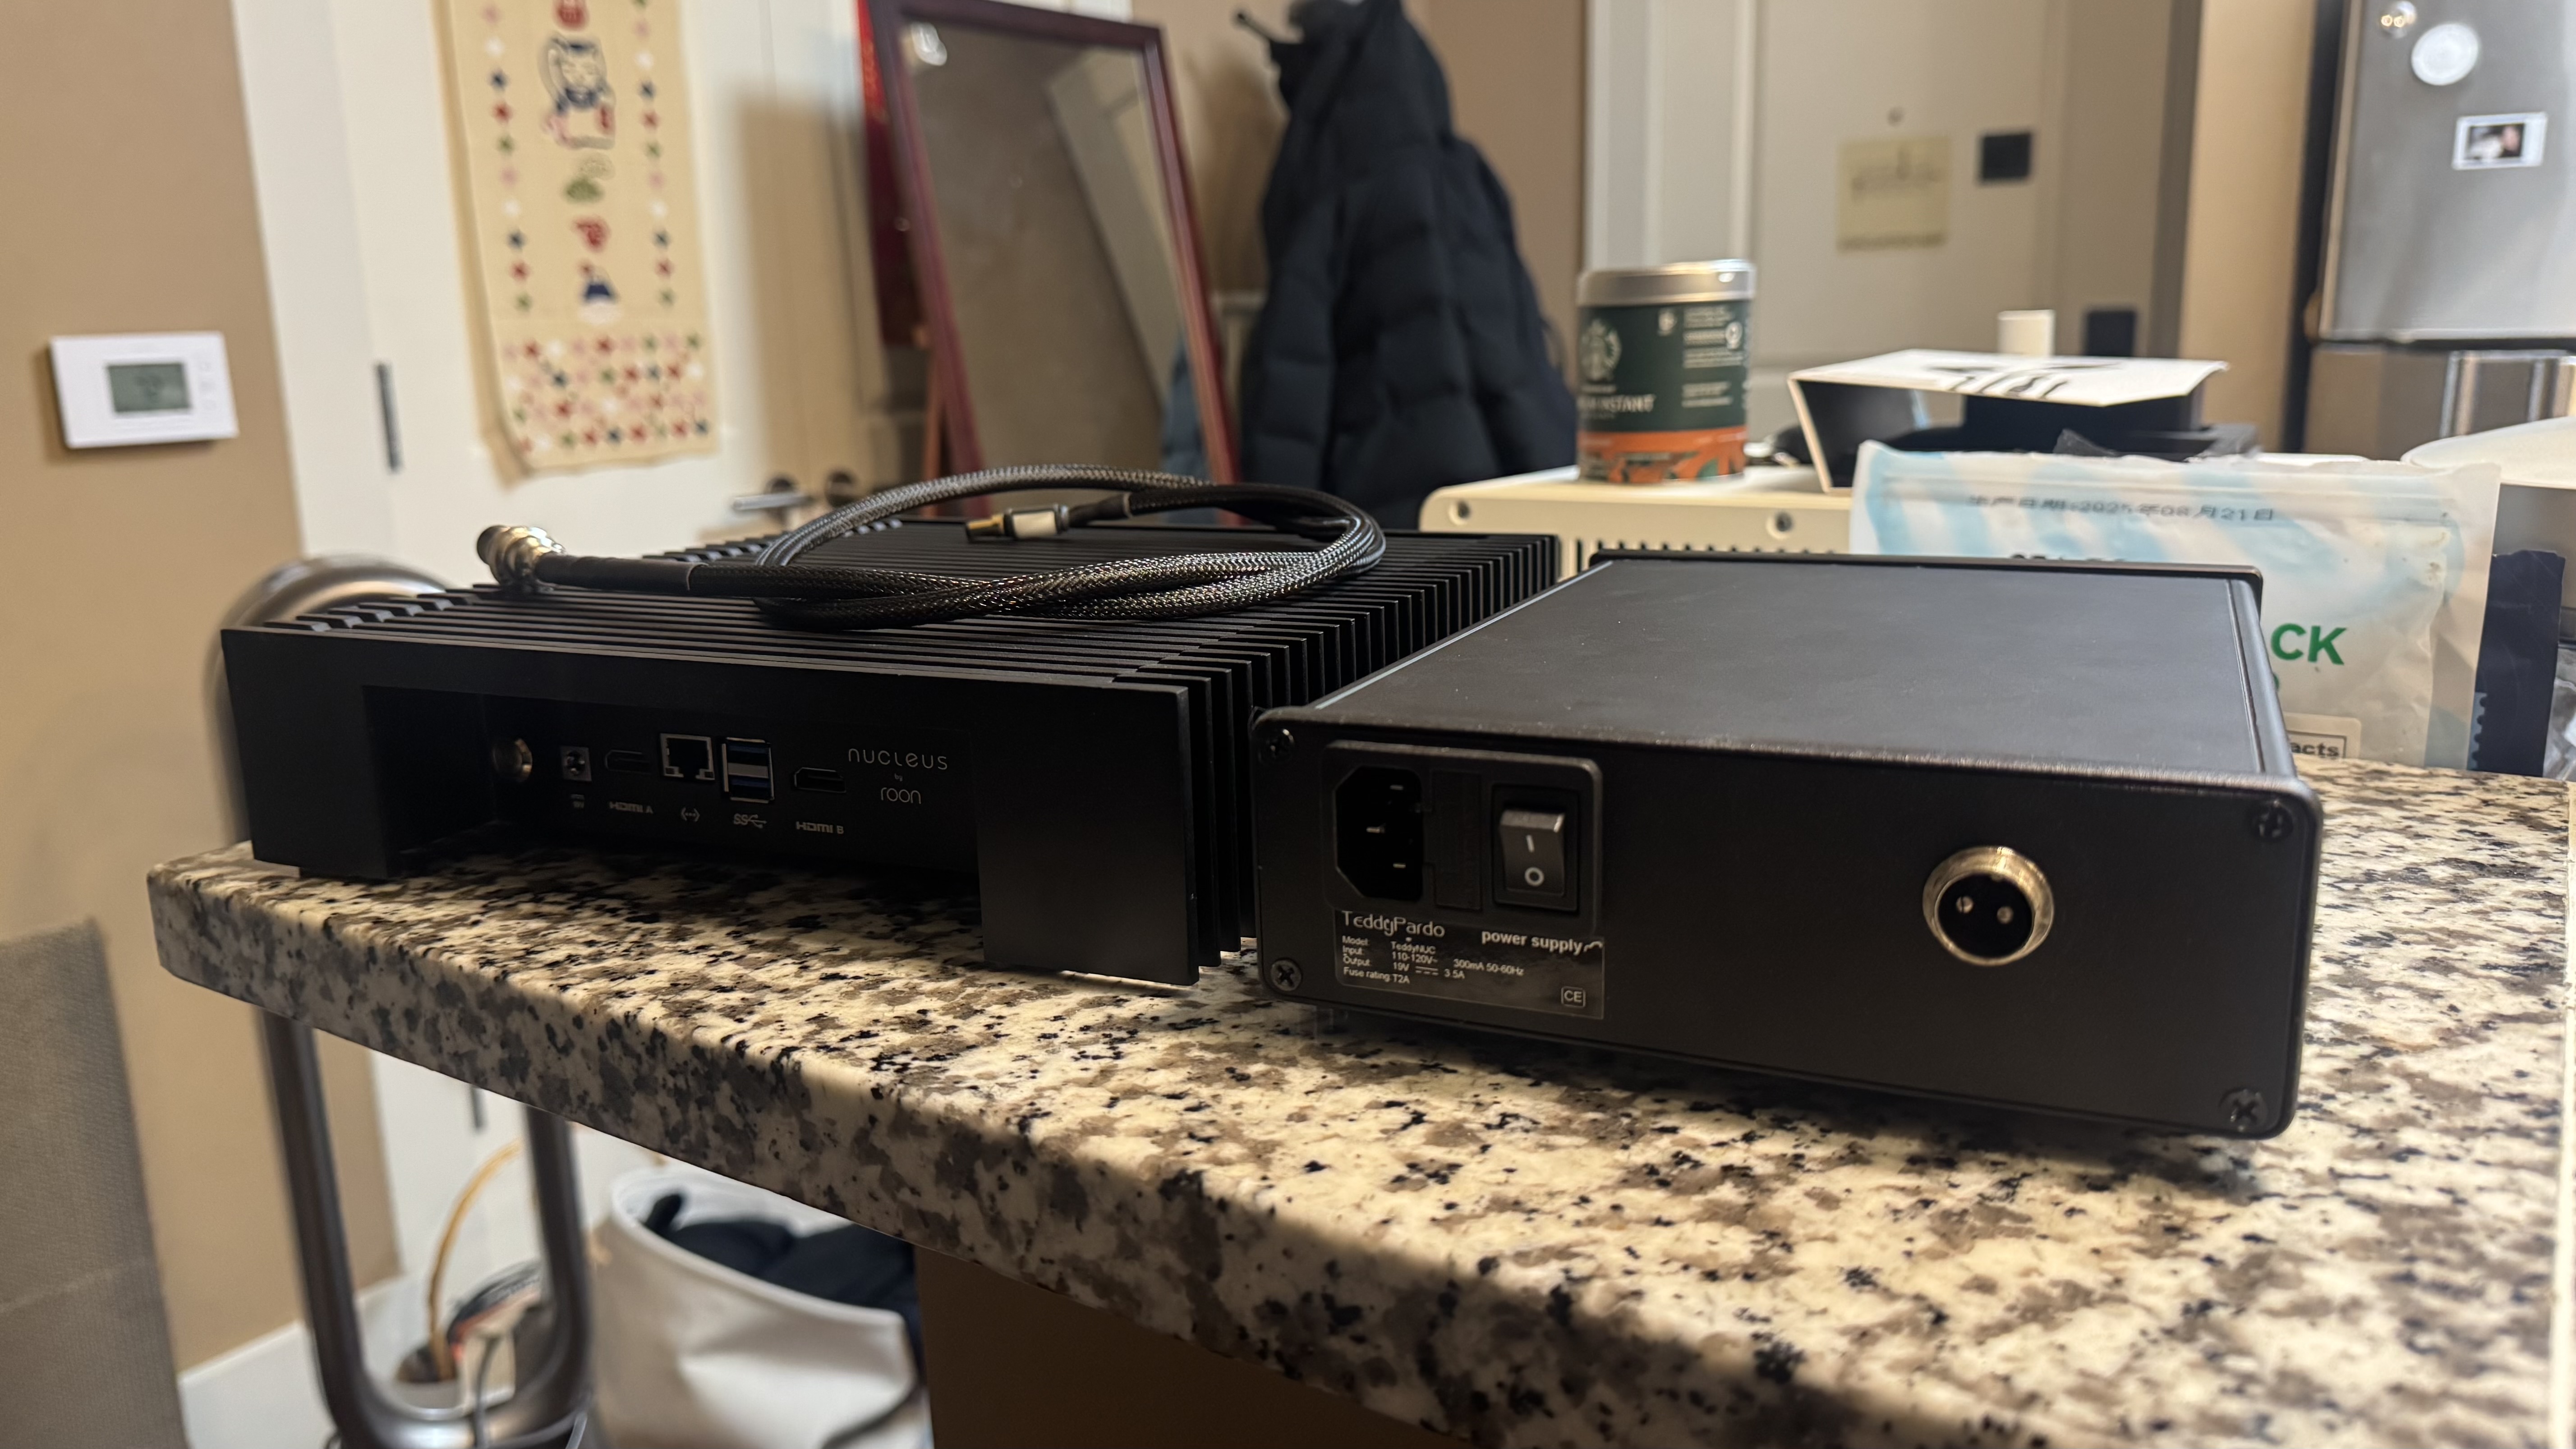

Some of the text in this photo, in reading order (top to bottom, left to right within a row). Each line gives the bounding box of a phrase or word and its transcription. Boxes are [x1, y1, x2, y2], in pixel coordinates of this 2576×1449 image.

[848, 748, 948, 770] nucleus
[894, 773, 903, 782] by
[880, 787, 922, 805] roon
[609, 801, 653, 814] HDMI A
[796, 821, 844, 835] HDMI B
[1342, 910, 1445, 938] TeddyPardo
[1390, 941, 1436, 955] TeddyNUC
[1481, 930, 1583, 956] power supply
[1343, 966, 1411, 984] Fuse rating T2A
[1453, 958, 1484, 971] 300mA
[1486, 962, 1525, 977] 50-60Hz
